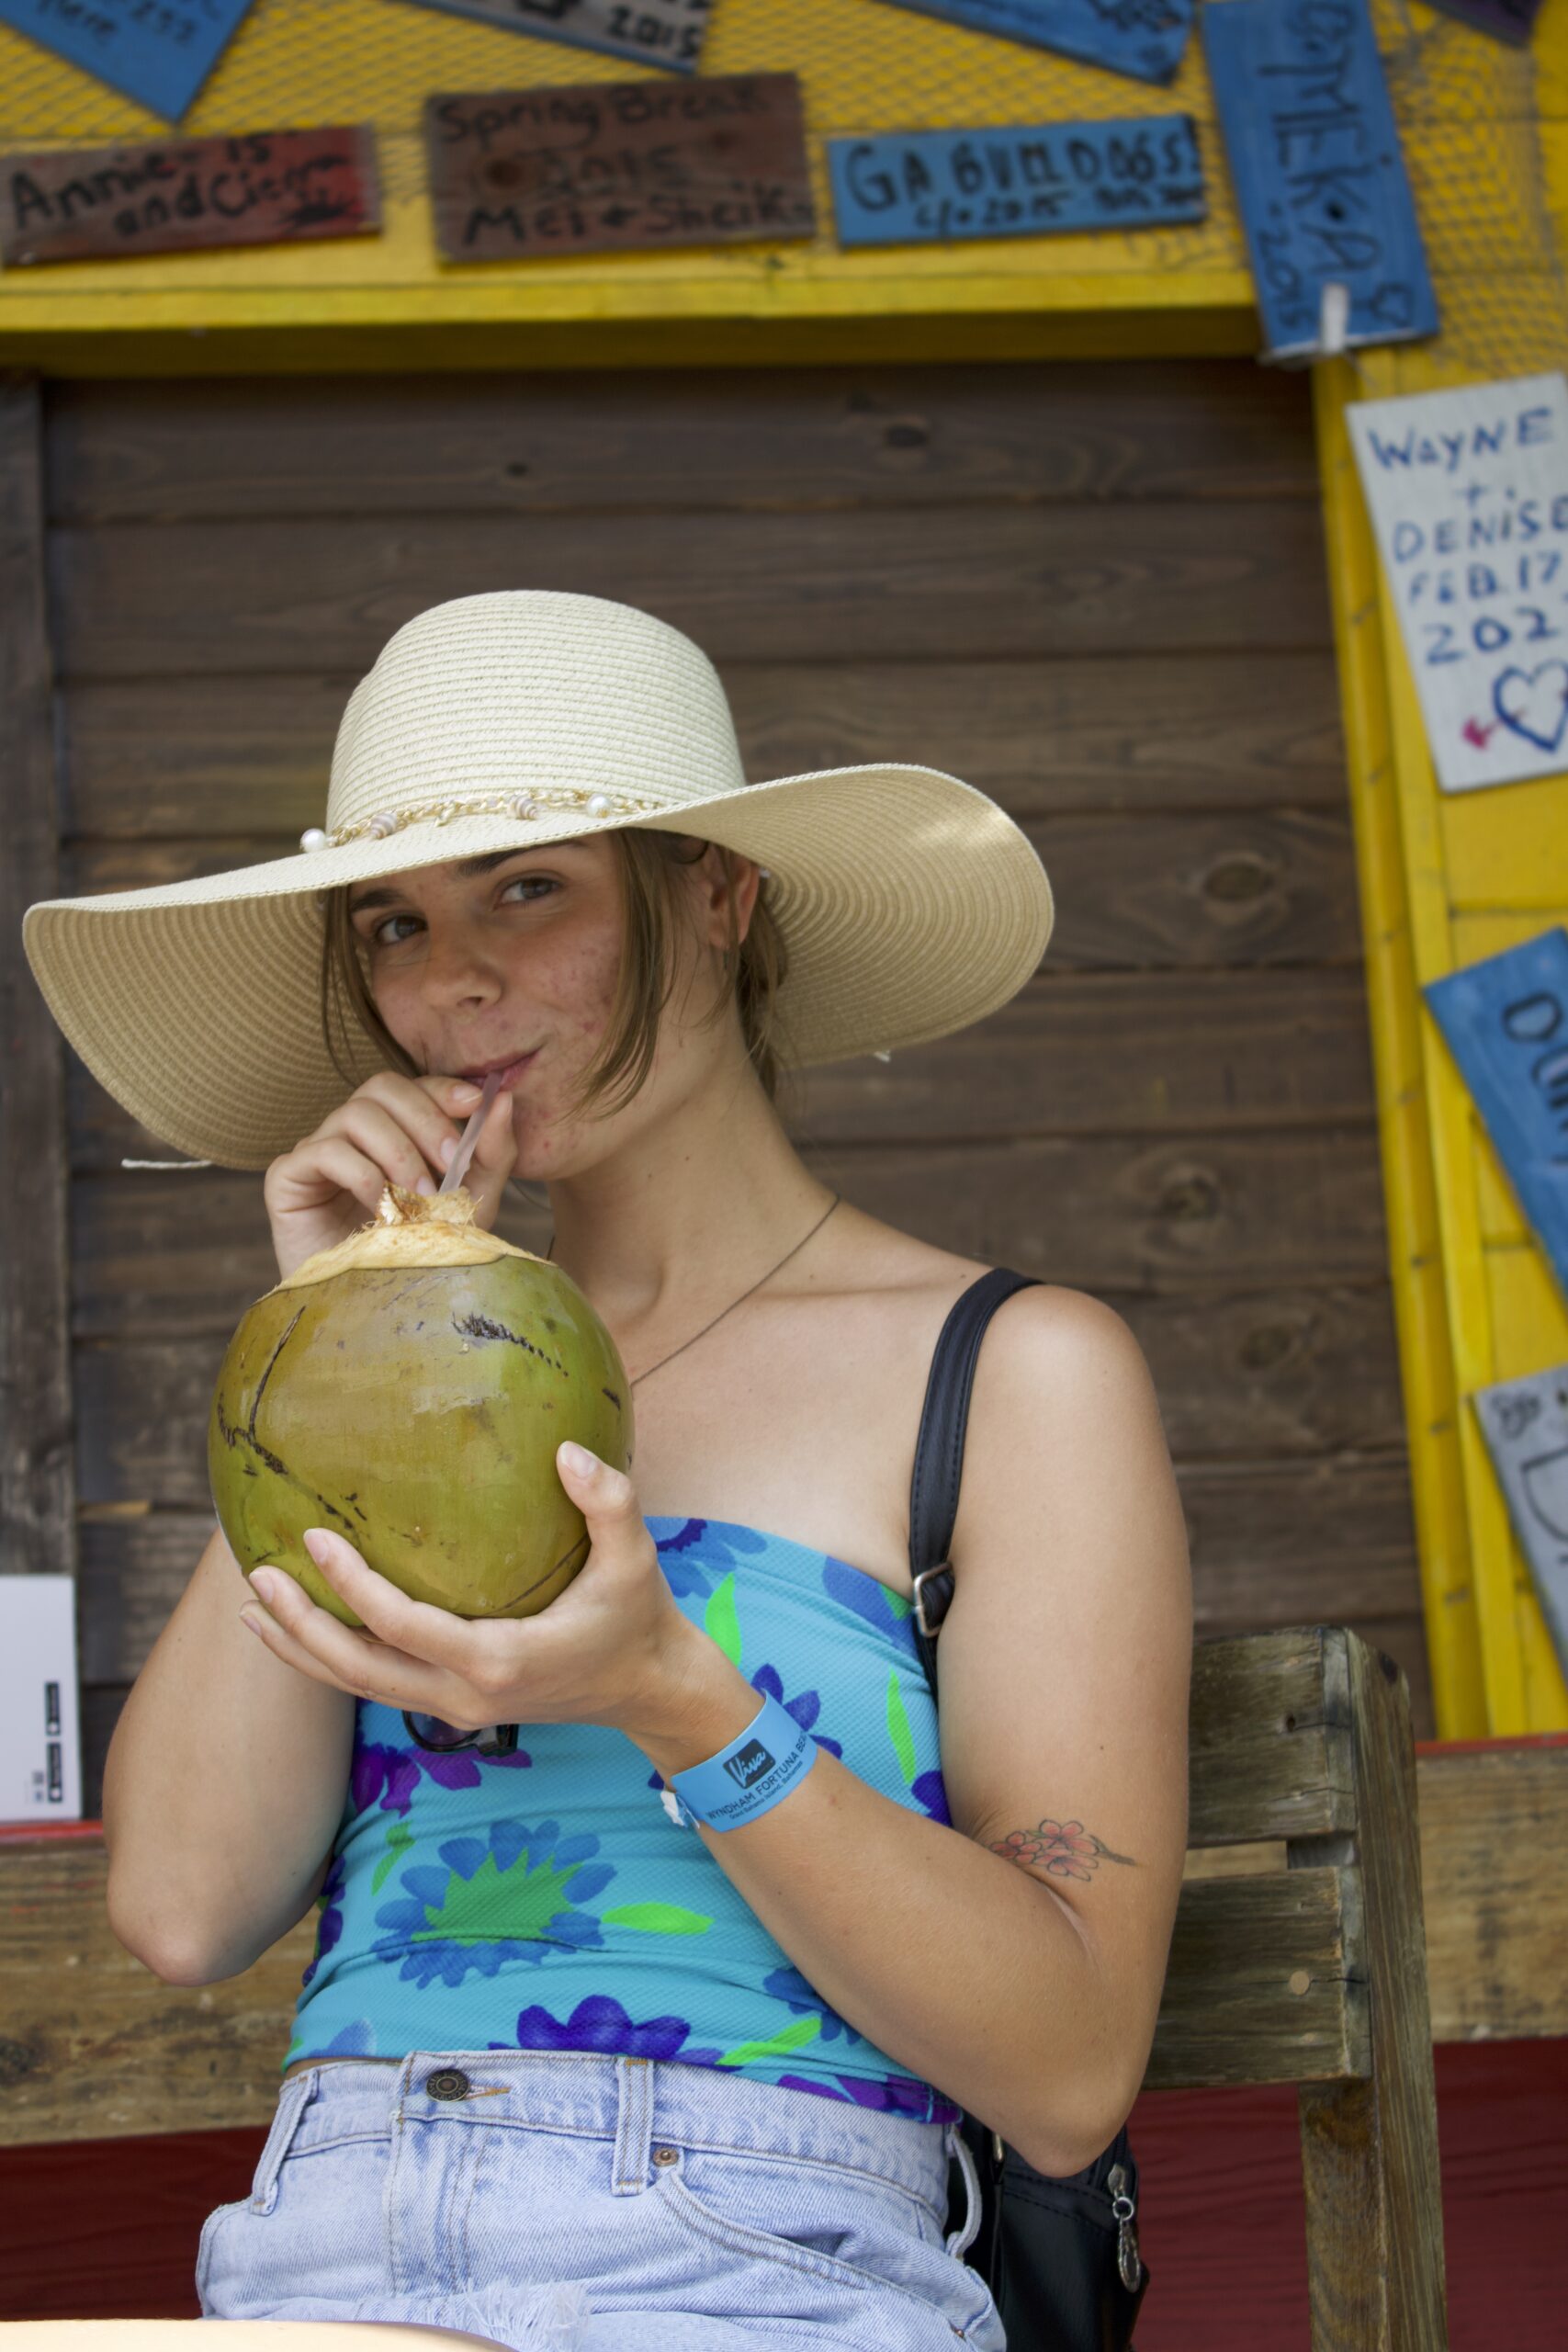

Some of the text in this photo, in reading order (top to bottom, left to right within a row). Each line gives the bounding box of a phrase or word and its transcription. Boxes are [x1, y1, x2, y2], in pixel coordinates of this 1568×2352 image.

[705, 1792, 756, 1820] WYNDHAM
[754, 1751, 800, 1795] FORTUNA
[728, 1750, 767, 1788] Viva
